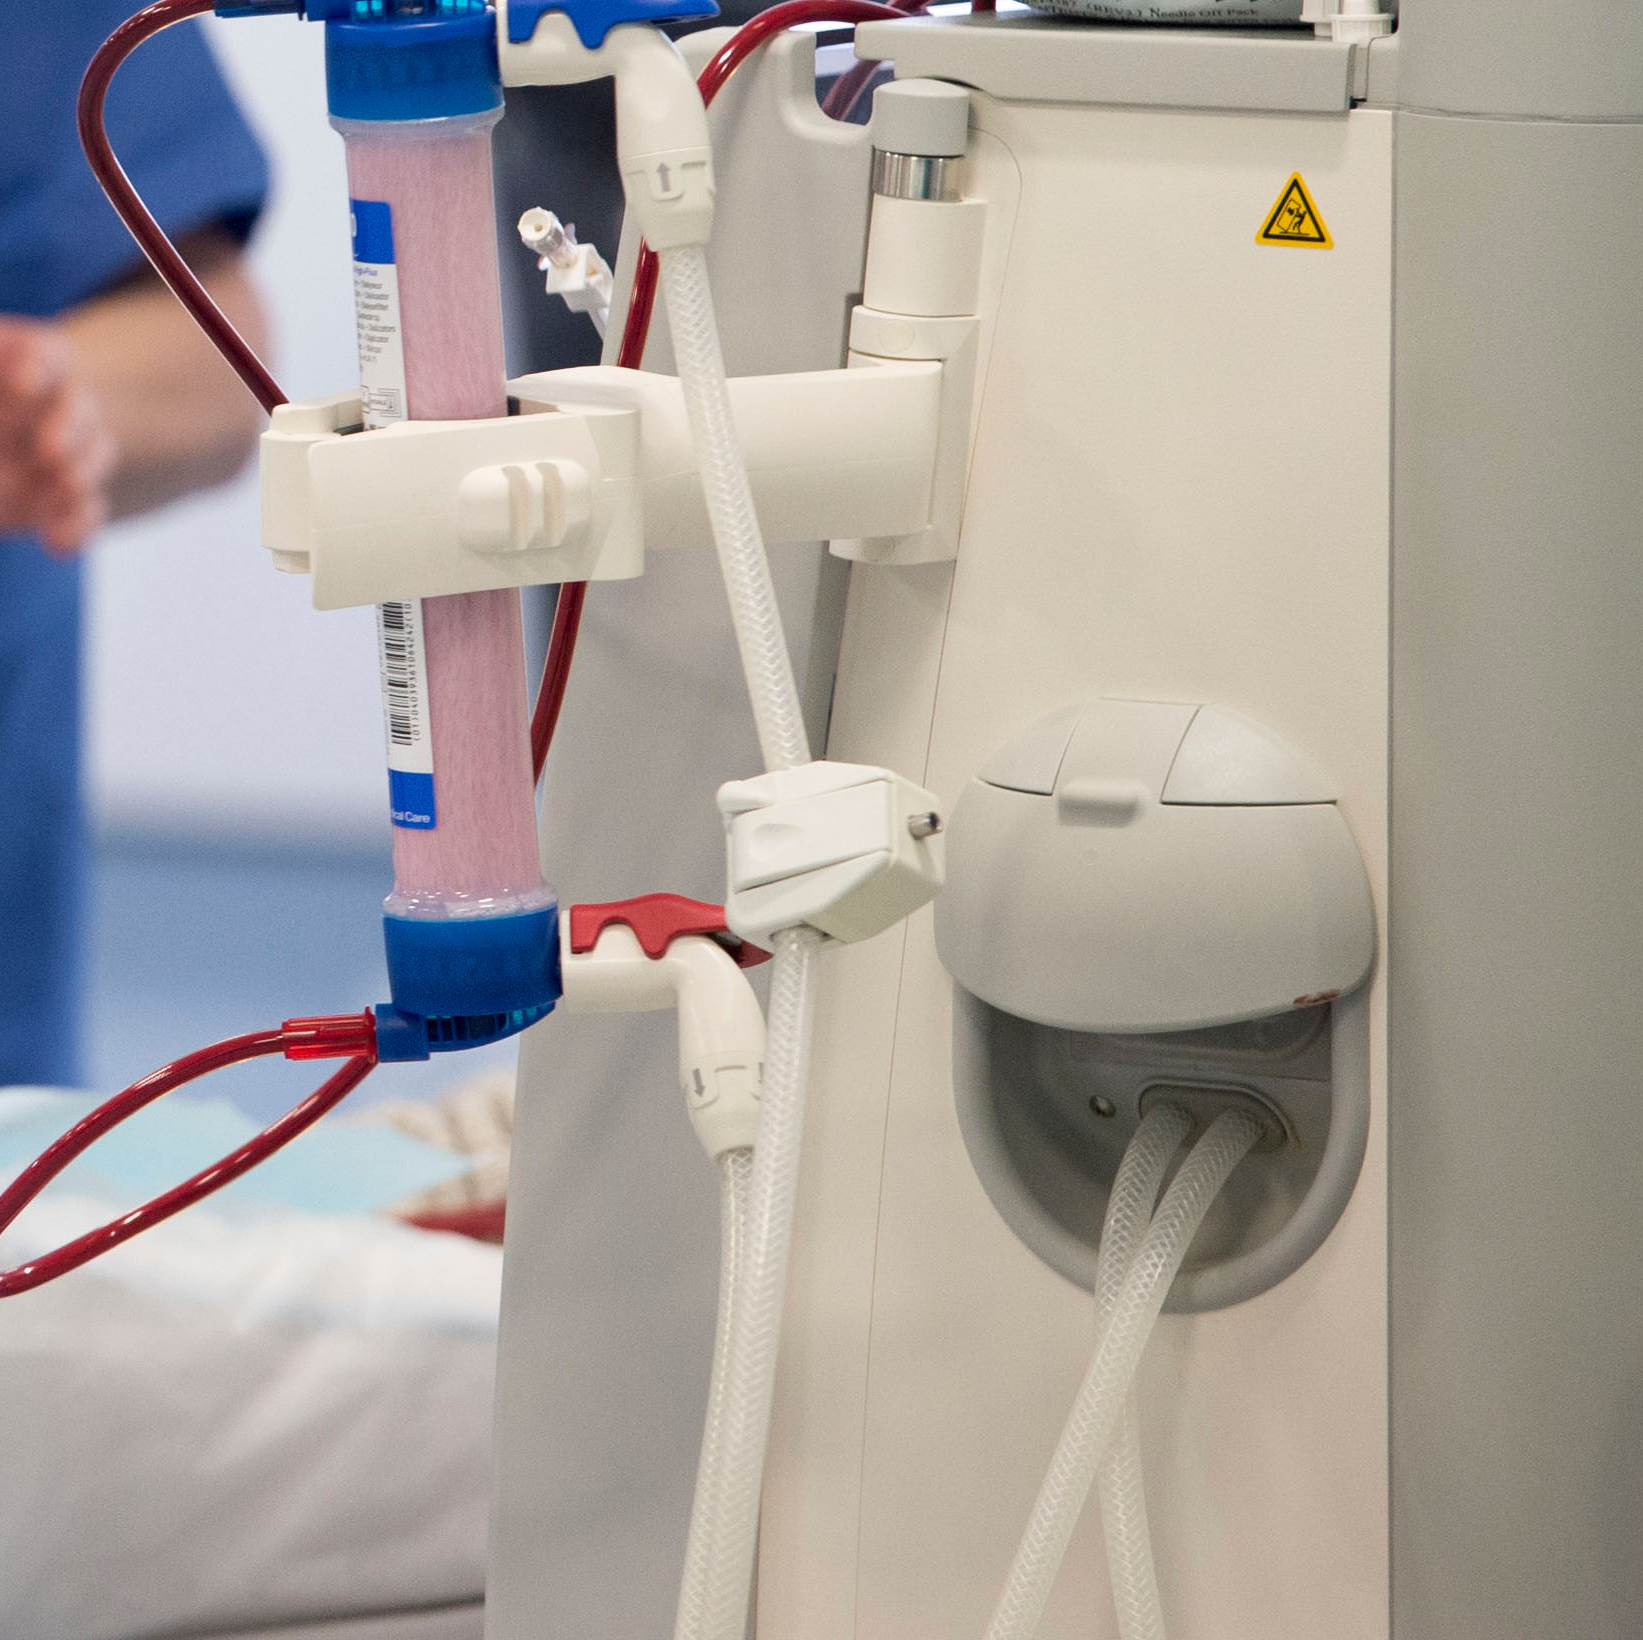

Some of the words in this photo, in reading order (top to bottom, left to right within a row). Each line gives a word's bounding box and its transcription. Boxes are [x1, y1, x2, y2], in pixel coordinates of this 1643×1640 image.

[1149, 7, 1197, 19] Needle
[405, 598, 421, 742] (01)04039361064242(10
[404, 811, 431, 824] Care
